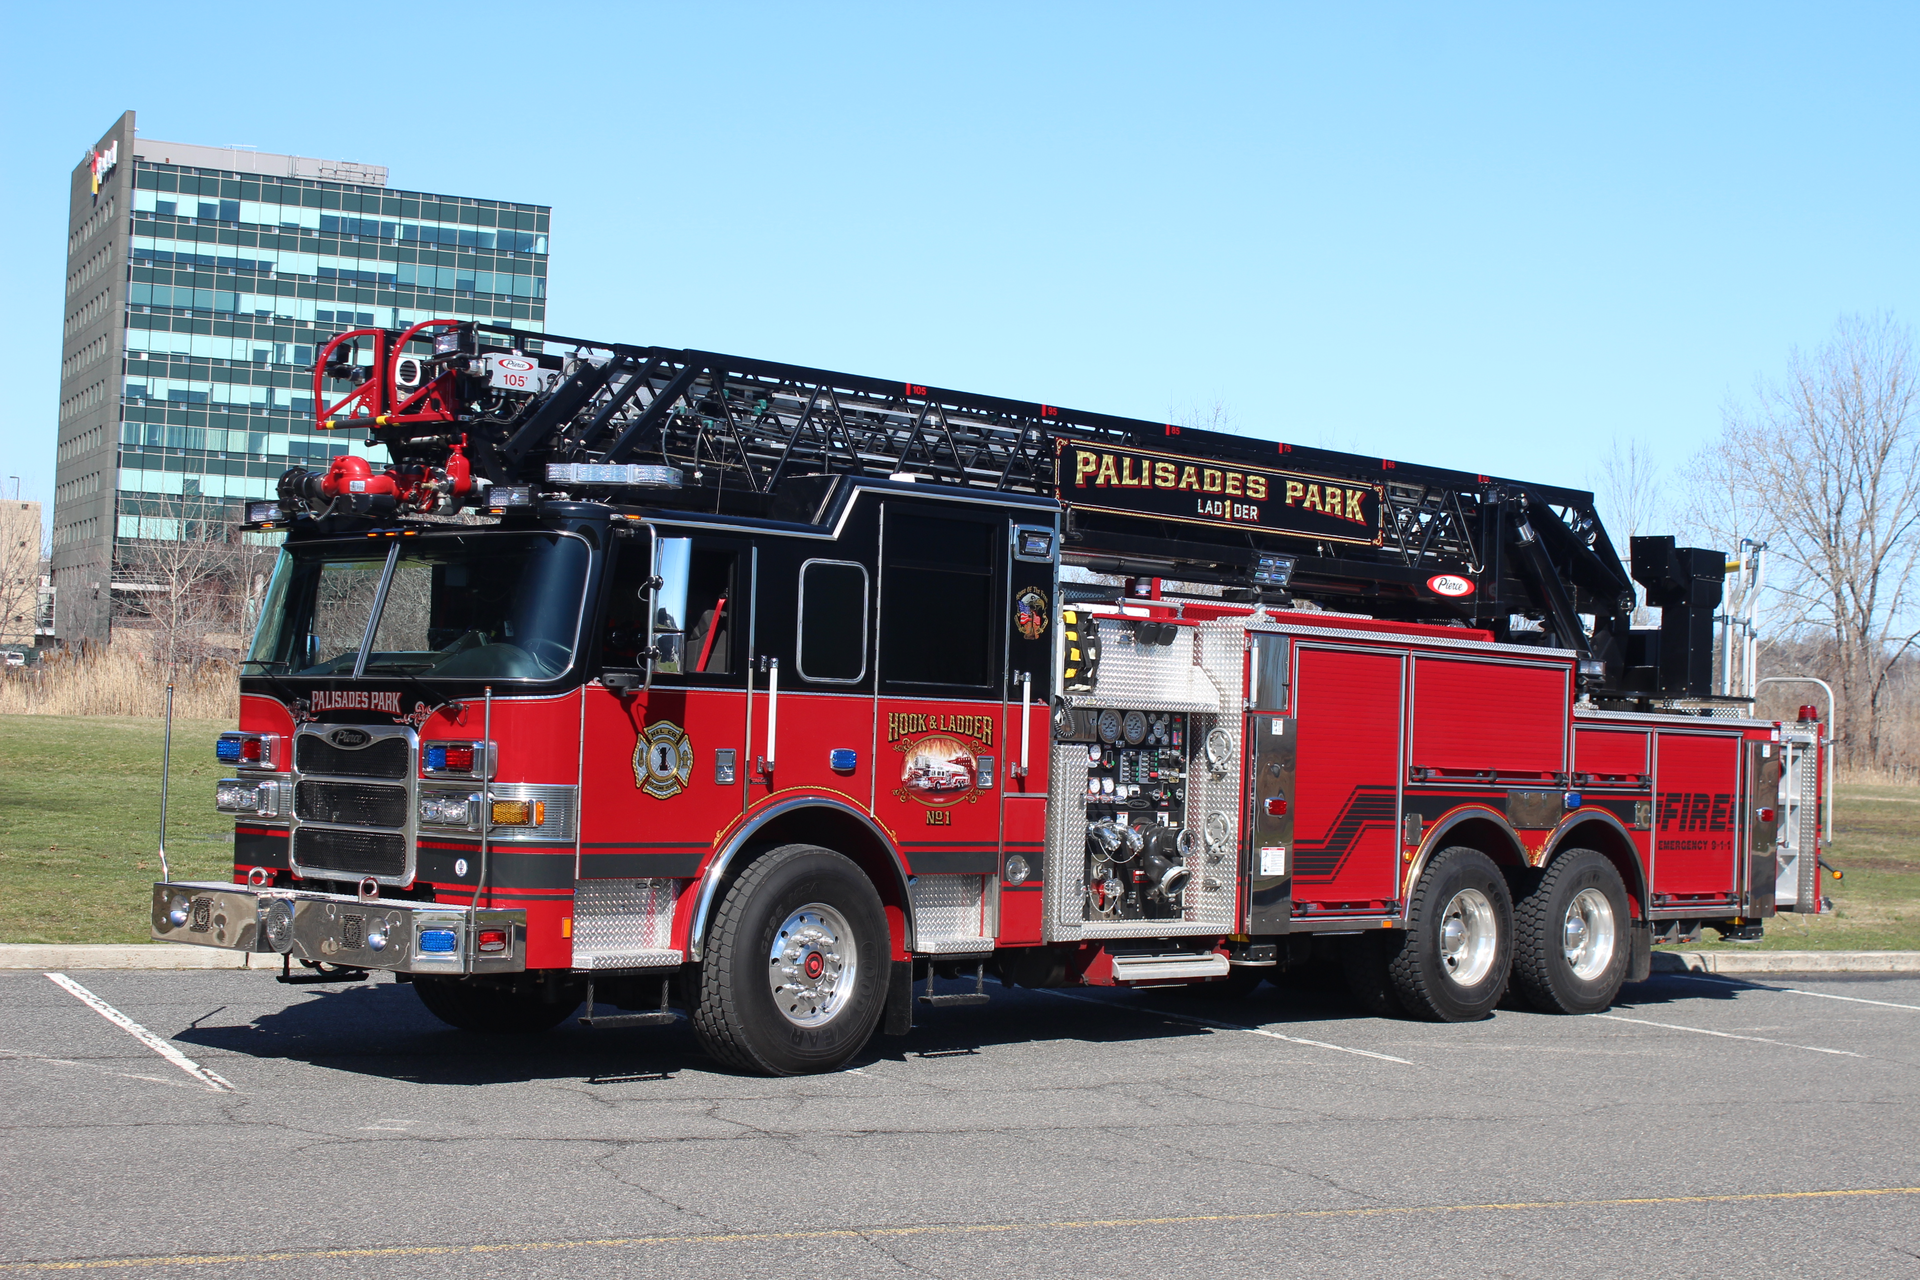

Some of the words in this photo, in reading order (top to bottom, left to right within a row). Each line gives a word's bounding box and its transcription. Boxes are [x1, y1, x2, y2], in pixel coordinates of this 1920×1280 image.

[505, 359, 526, 369] Pierce
[503, 374, 528, 387] 105'
[912, 385, 927, 396] 105
[1047, 407, 1058, 416] 95
[1171, 427, 1180, 435] 85
[1283, 444, 1292, 452] 75
[1387, 461, 1396, 469] 65
[1074, 450, 1268, 500] PALISADES
[1284, 479, 1367, 526] PARK
[1437, 577, 1464, 591] Pierce
[311, 690, 370, 713] PALISADES
[371, 691, 403, 715] PARK
[887, 712, 928, 742] HOOK
[929, 715, 938, 730] &
[940, 714, 993, 747] LADDER
[335, 729, 363, 744] Pierce
[659, 746, 668, 771] 1
[1661, 793, 1731, 832] FIRE
[1658, 840, 1708, 851] EMERGENCY
[1711, 840, 1731, 851] 9-1-1
